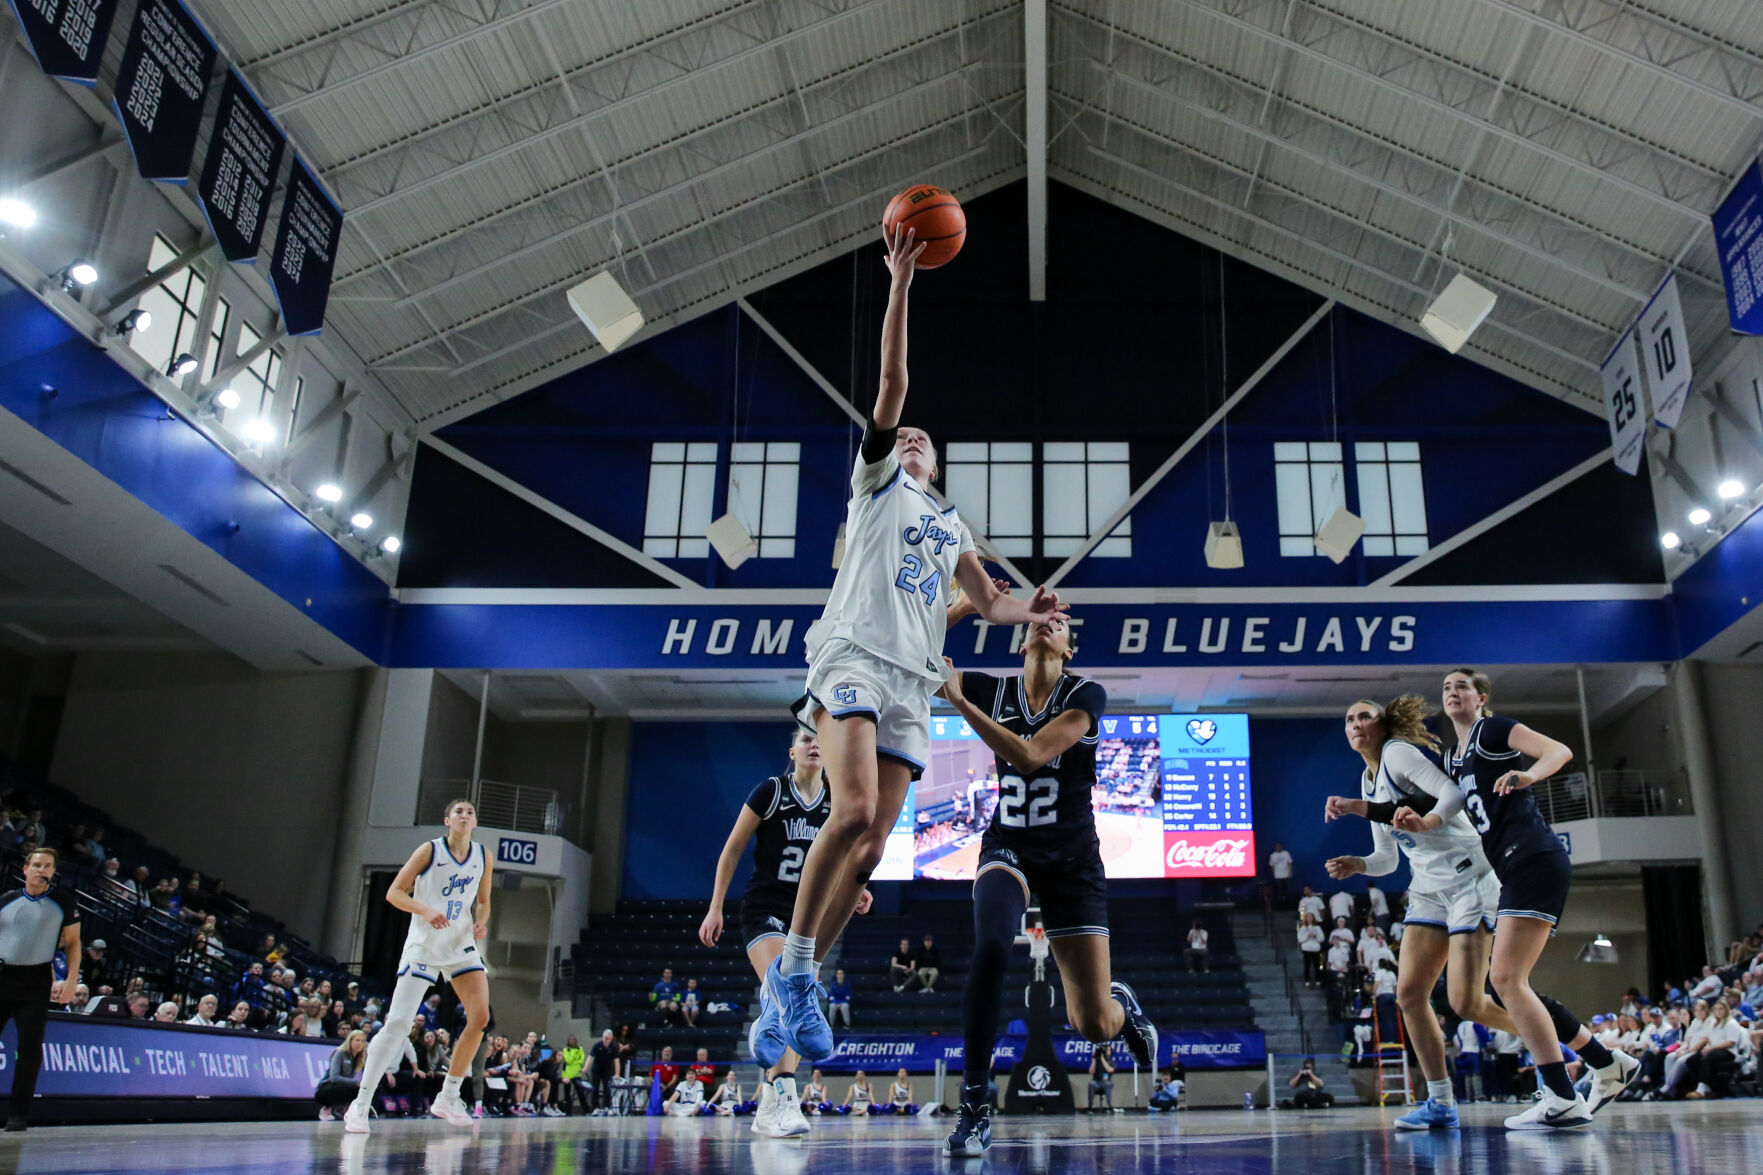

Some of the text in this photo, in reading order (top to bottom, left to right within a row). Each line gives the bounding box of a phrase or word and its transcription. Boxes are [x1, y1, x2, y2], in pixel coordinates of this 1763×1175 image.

[59, 20, 88, 61] 2020
[64, 5, 92, 45] 2019
[151, 6, 202, 73] CONFERENCE
[140, 9, 177, 60] REGULAR
[175, 53, 204, 95] SEASON
[141, 28, 199, 101] CHAMPIONSHIP
[141, 52, 164, 88] 2021
[131, 81, 158, 118] 2023
[136, 65, 162, 104] 2022
[126, 95, 154, 134] 2024
[231, 104, 273, 161] CONFERENCE
[222, 127, 269, 187] CHAMPIONSHIP
[222, 147, 243, 178] 2012
[228, 118, 270, 172] TOURNAMENT
[215, 176, 236, 206] 2015
[218, 162, 240, 191] 2014
[244, 174, 263, 201] 2017
[211, 190, 233, 220] 2016
[296, 191, 331, 239] CONFERENCE
[294, 202, 329, 250] TOURNAMENT
[1654, 326, 1676, 381] 10
[1612, 375, 1636, 433] 25
[903, 515, 957, 555] Jays
[895, 554, 940, 606] 24
[661, 618, 813, 655] HOM
[1118, 615, 1415, 653] BLUEJAYS
[1147, 722, 1157, 734] 4
[1000, 774, 1060, 828] 22
[500, 841, 535, 863] 106
[441, 873, 474, 897] Jays
[446, 900, 463, 921] 13
[42, 1043, 291, 1081] INANCIAL TECH TALENT M&A
[837, 1041, 915, 1056] CREIGHTON
[944, 1047, 963, 1058] THE
[1171, 1043, 1241, 1054] THE BIRDCAGE
